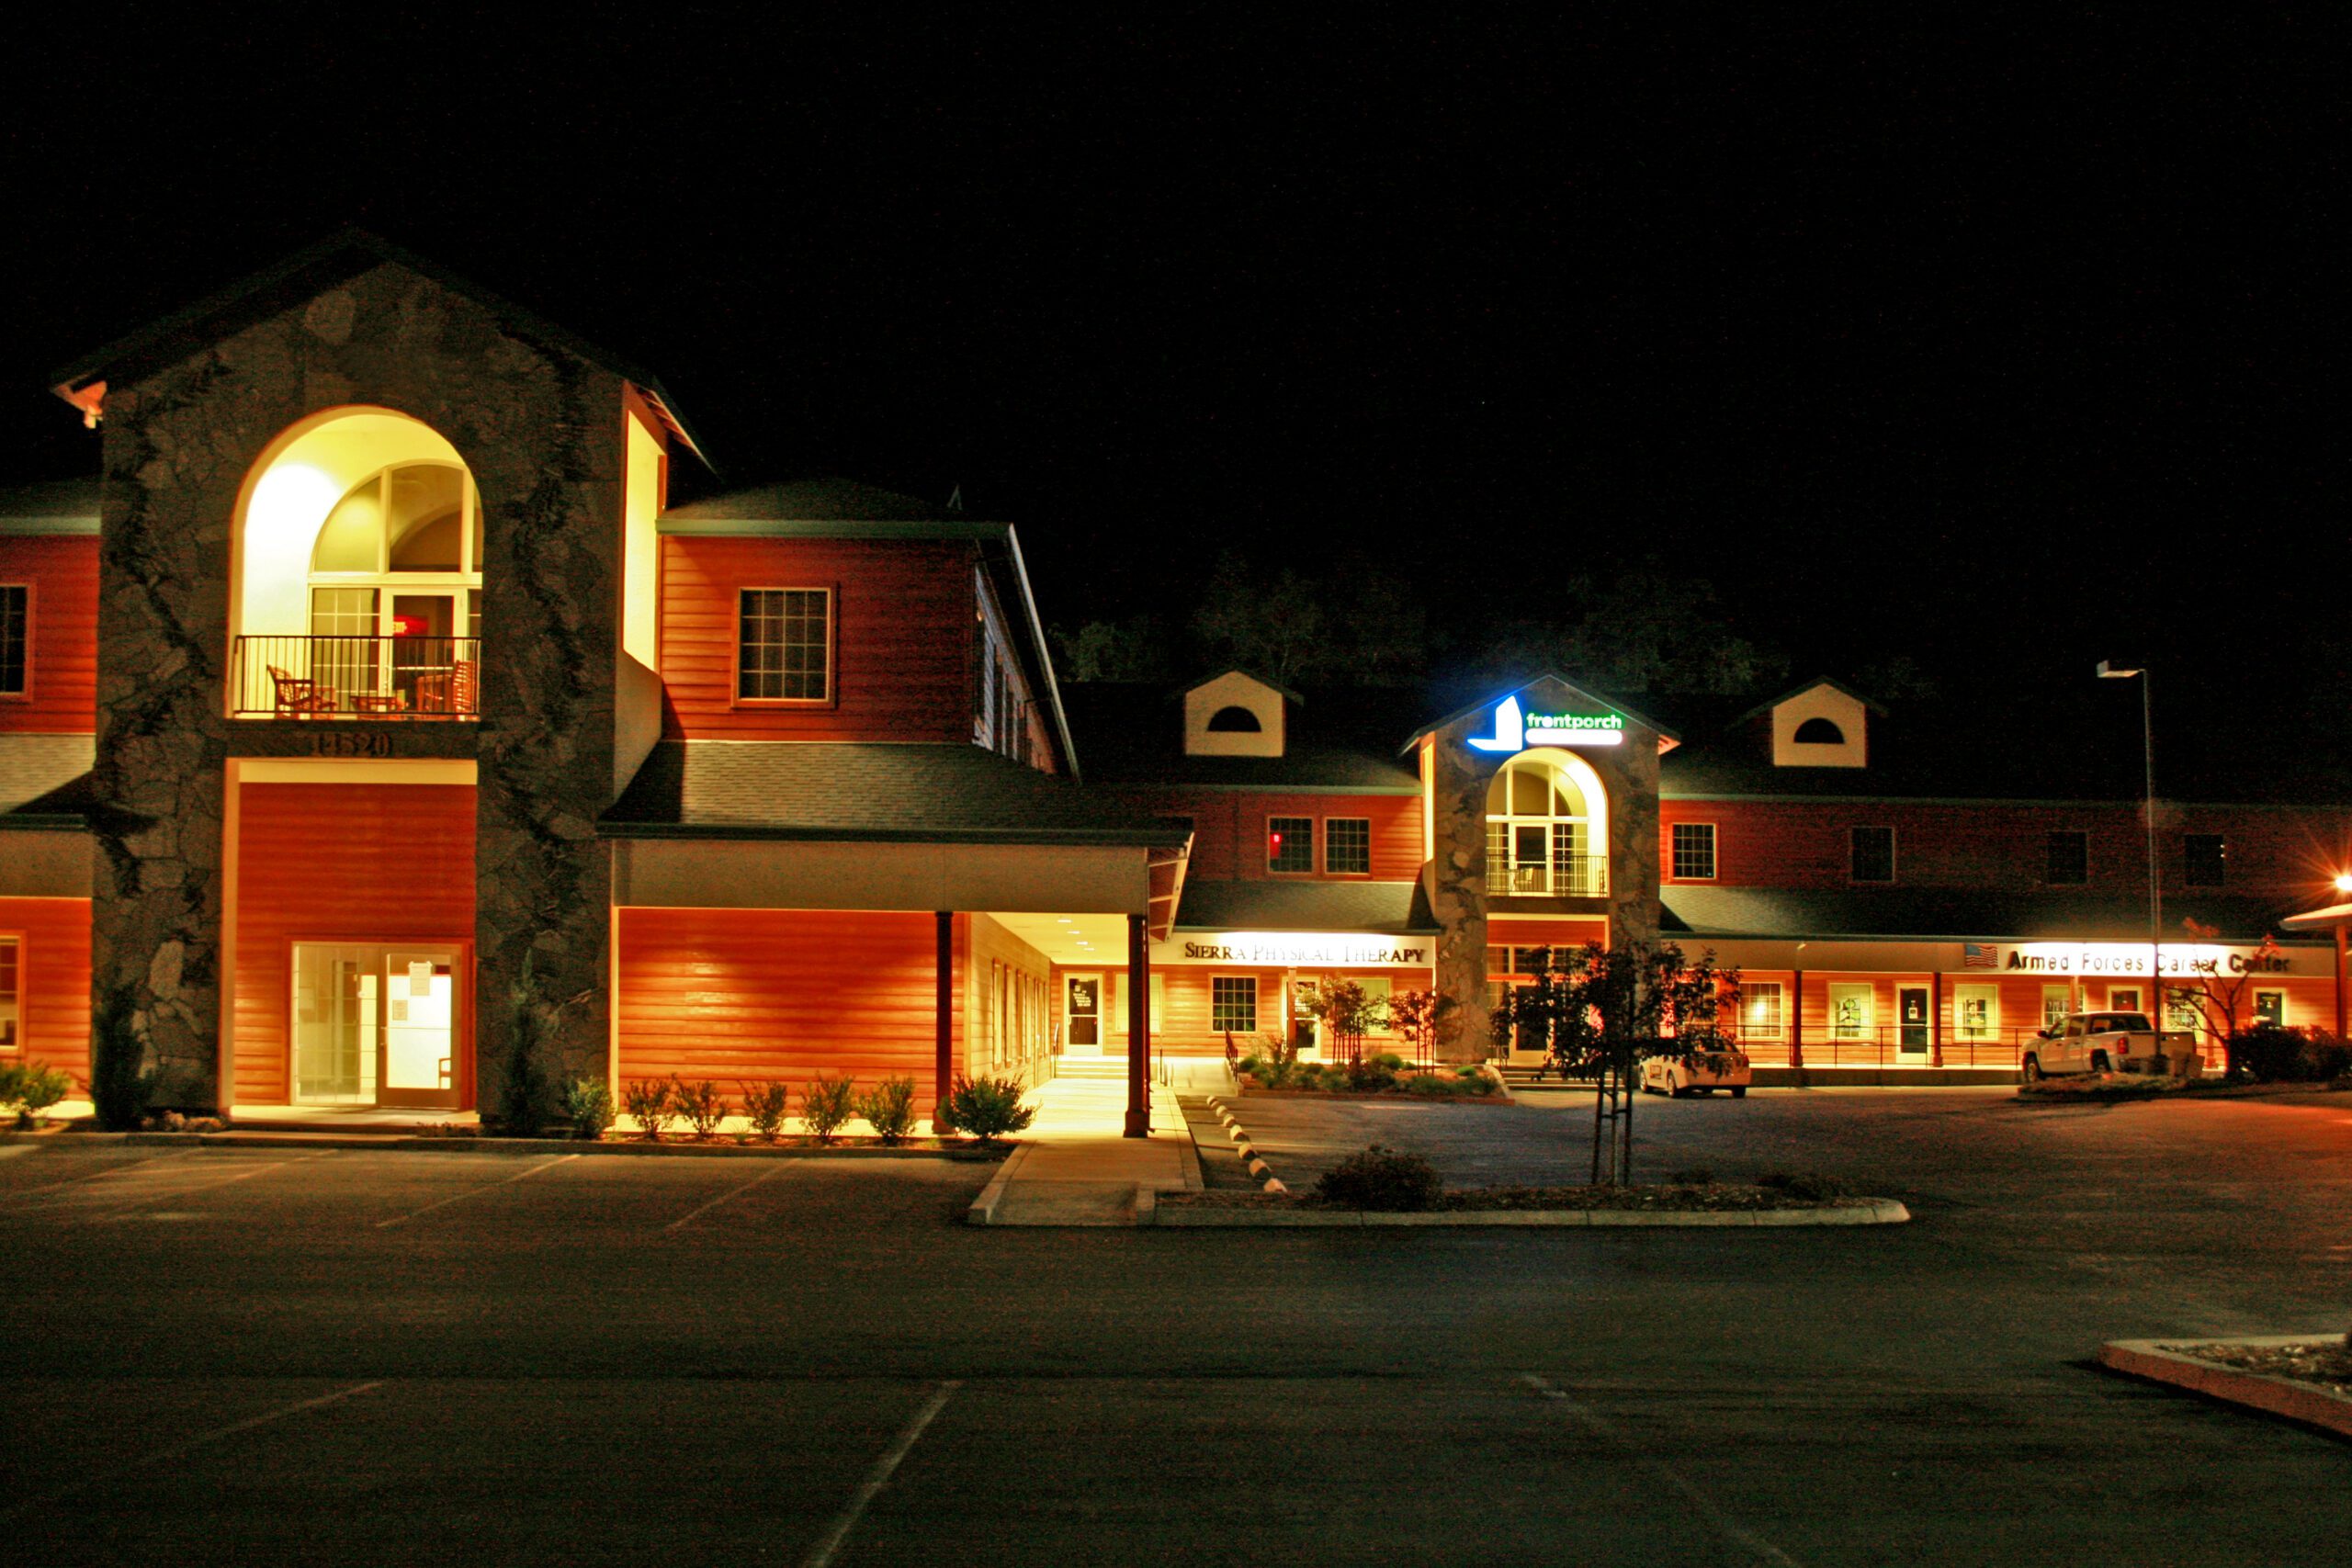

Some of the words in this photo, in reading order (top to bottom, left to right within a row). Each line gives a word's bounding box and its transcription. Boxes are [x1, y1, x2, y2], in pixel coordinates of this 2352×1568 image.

[1526, 712, 1623, 729] frontporch
[1184, 942, 1247, 961] SIERRA
[1251, 943, 1334, 962] PHYSICAL
[1341, 945, 1427, 964] THERAPY
[2006, 950, 2069, 971] Armed
[2081, 953, 2144, 972] Forces
